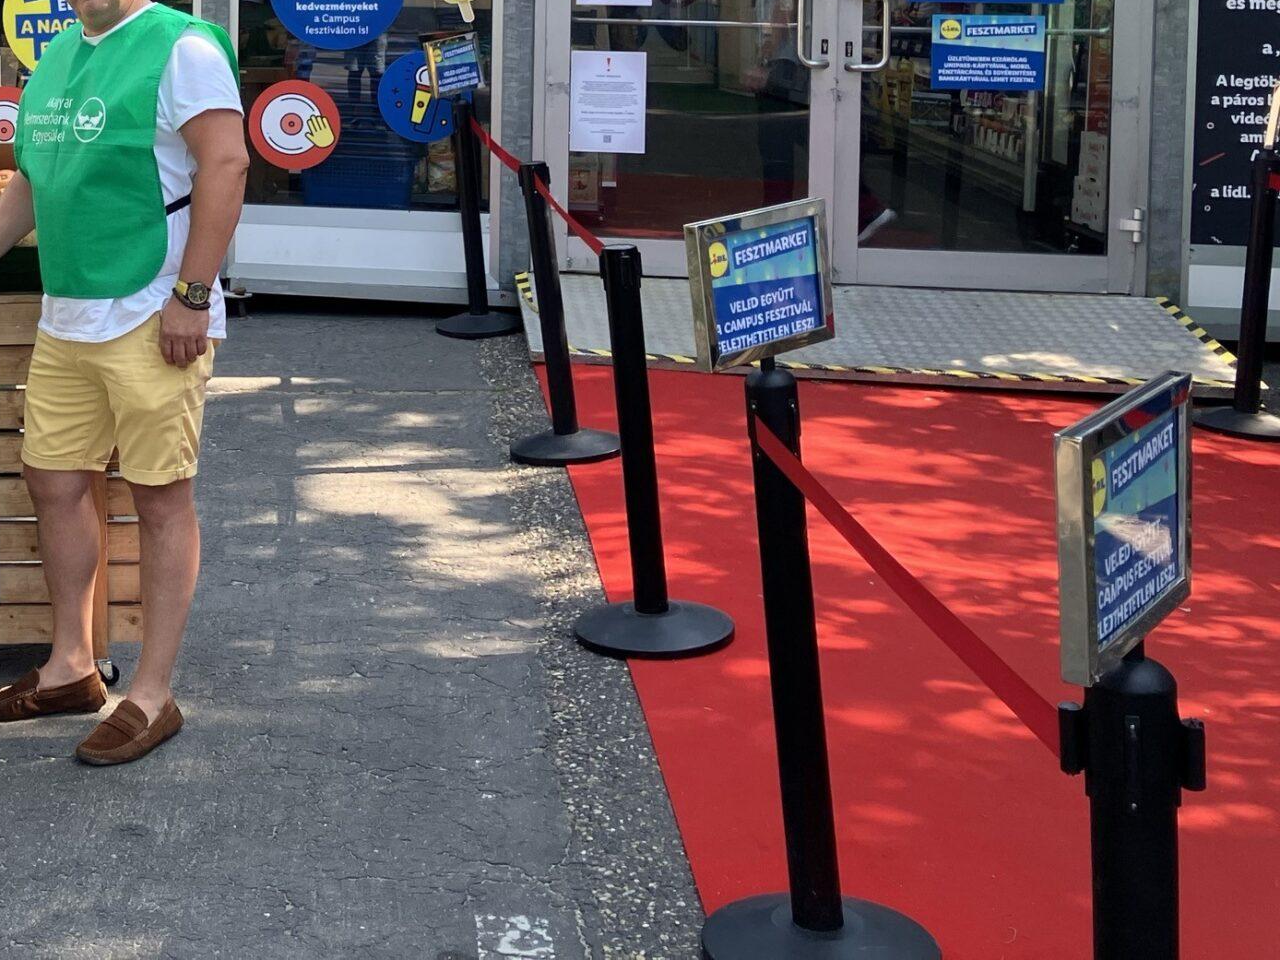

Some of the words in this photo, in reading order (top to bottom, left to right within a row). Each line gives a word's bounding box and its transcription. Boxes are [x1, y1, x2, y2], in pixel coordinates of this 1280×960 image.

[295, 1, 379, 12] kedvezményeket
[321, 14, 360, 24] Campus
[20, 20, 34, 34] A
[305, 26, 356, 35] fesztiválon
[358, 26, 369, 34] is!
[966, 25, 1036, 36] FESZTMARKET
[1262, 43, 1273, 55] a
[1216, 75, 1227, 87] A
[1211, 96, 1220, 106] a
[1222, 94, 1264, 108] páros
[1210, 187, 1219, 198] a
[1222, 185, 1251, 199] lidl.
[735, 230, 808, 266] FESZTMARKET
[729, 296, 759, 314] VELED
[761, 287, 795, 307] EGYÜTT
[724, 313, 764, 334] CAMPUS
[765, 299, 813, 323] FESZTIVÁL
[791, 317, 815, 334] LESZ!
[1112, 422, 1174, 493] FESZTMARKET
[1104, 542, 1131, 576] VELED
[1098, 568, 1134, 610] CAMPUS
[1097, 578, 1156, 641] LEJTHETETLEN
[1156, 562, 1176, 593] LESZ!
